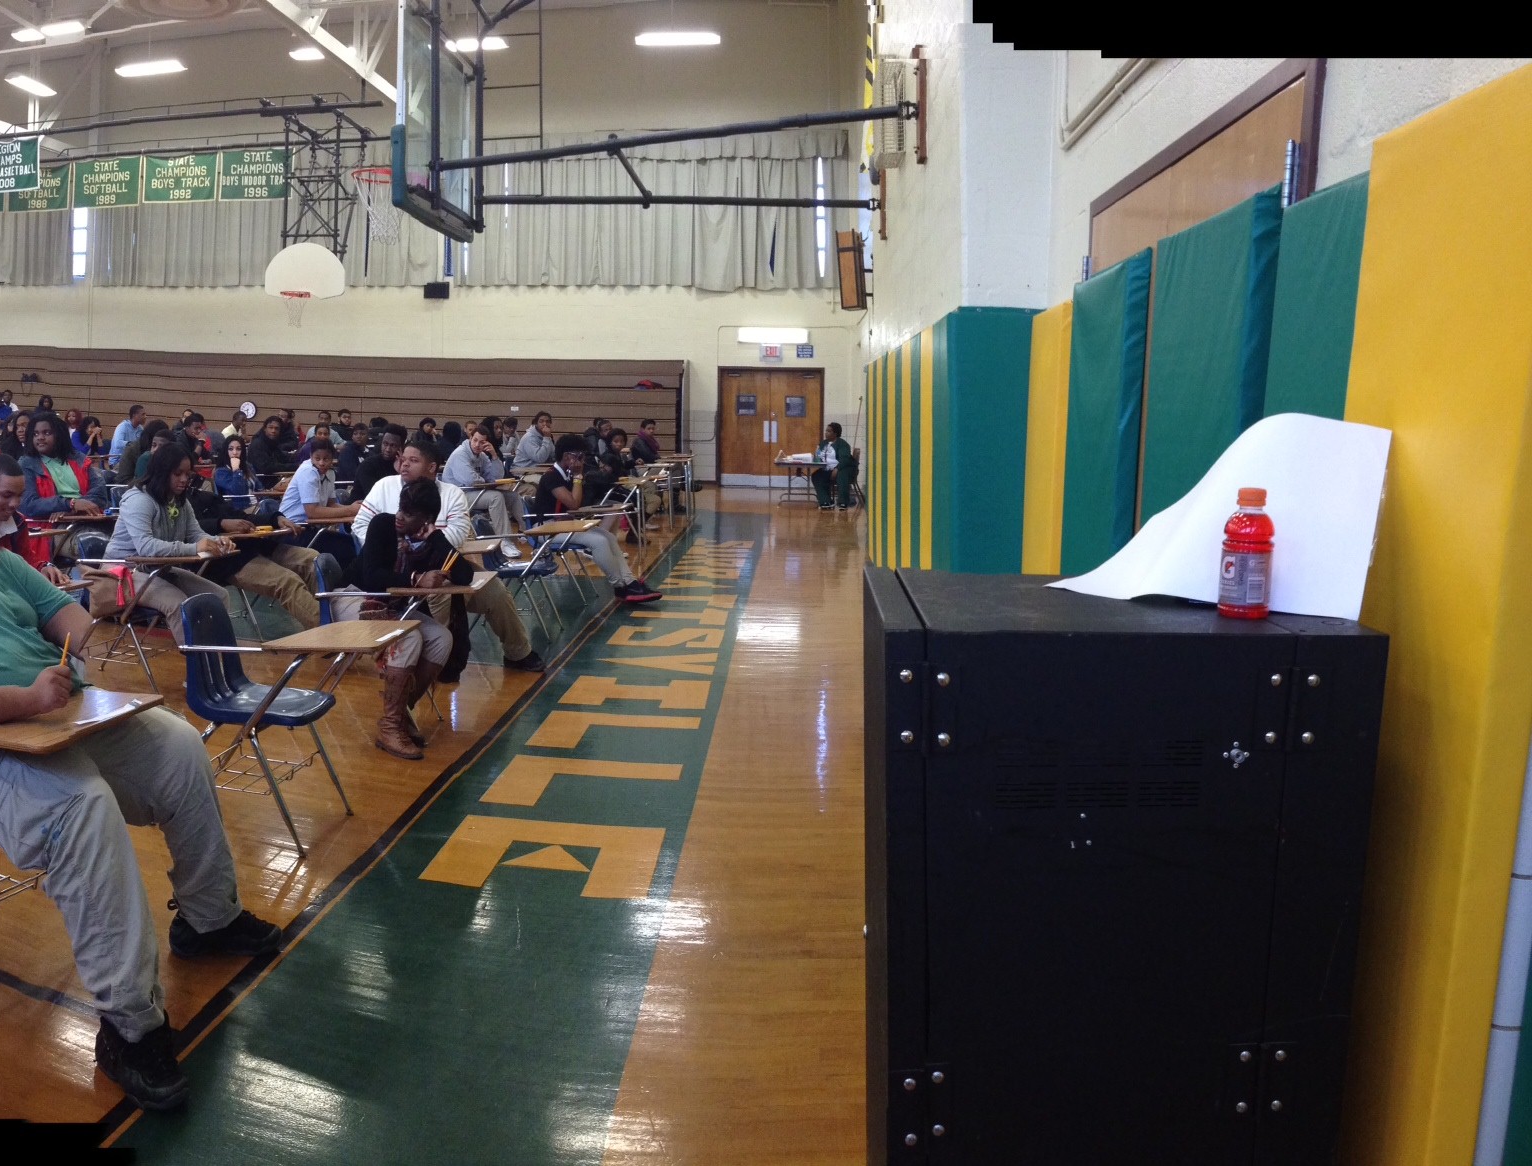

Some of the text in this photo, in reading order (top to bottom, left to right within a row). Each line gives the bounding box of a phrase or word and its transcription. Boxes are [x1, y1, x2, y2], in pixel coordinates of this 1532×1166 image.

[168, 155, 195, 166] STATE
[244, 152, 272, 162] STATE
[95, 161, 119, 172] STATE
[156, 166, 207, 177] CHAMPIONS
[231, 164, 284, 174] CHAMPIONS
[83, 172, 130, 183] CHAMPIONS
[222, 175, 285, 186] BOYS INDOOR TRA
[152, 178, 210, 188] BOYS TRACK
[84, 183, 127, 194] SOFTBALL
[244, 187, 268, 197] 1996
[19, 189, 59, 199] SOFTBALL
[170, 190, 191, 199] 1992
[28, 200, 47, 208] 1988
[96, 195, 115, 205] 1989
